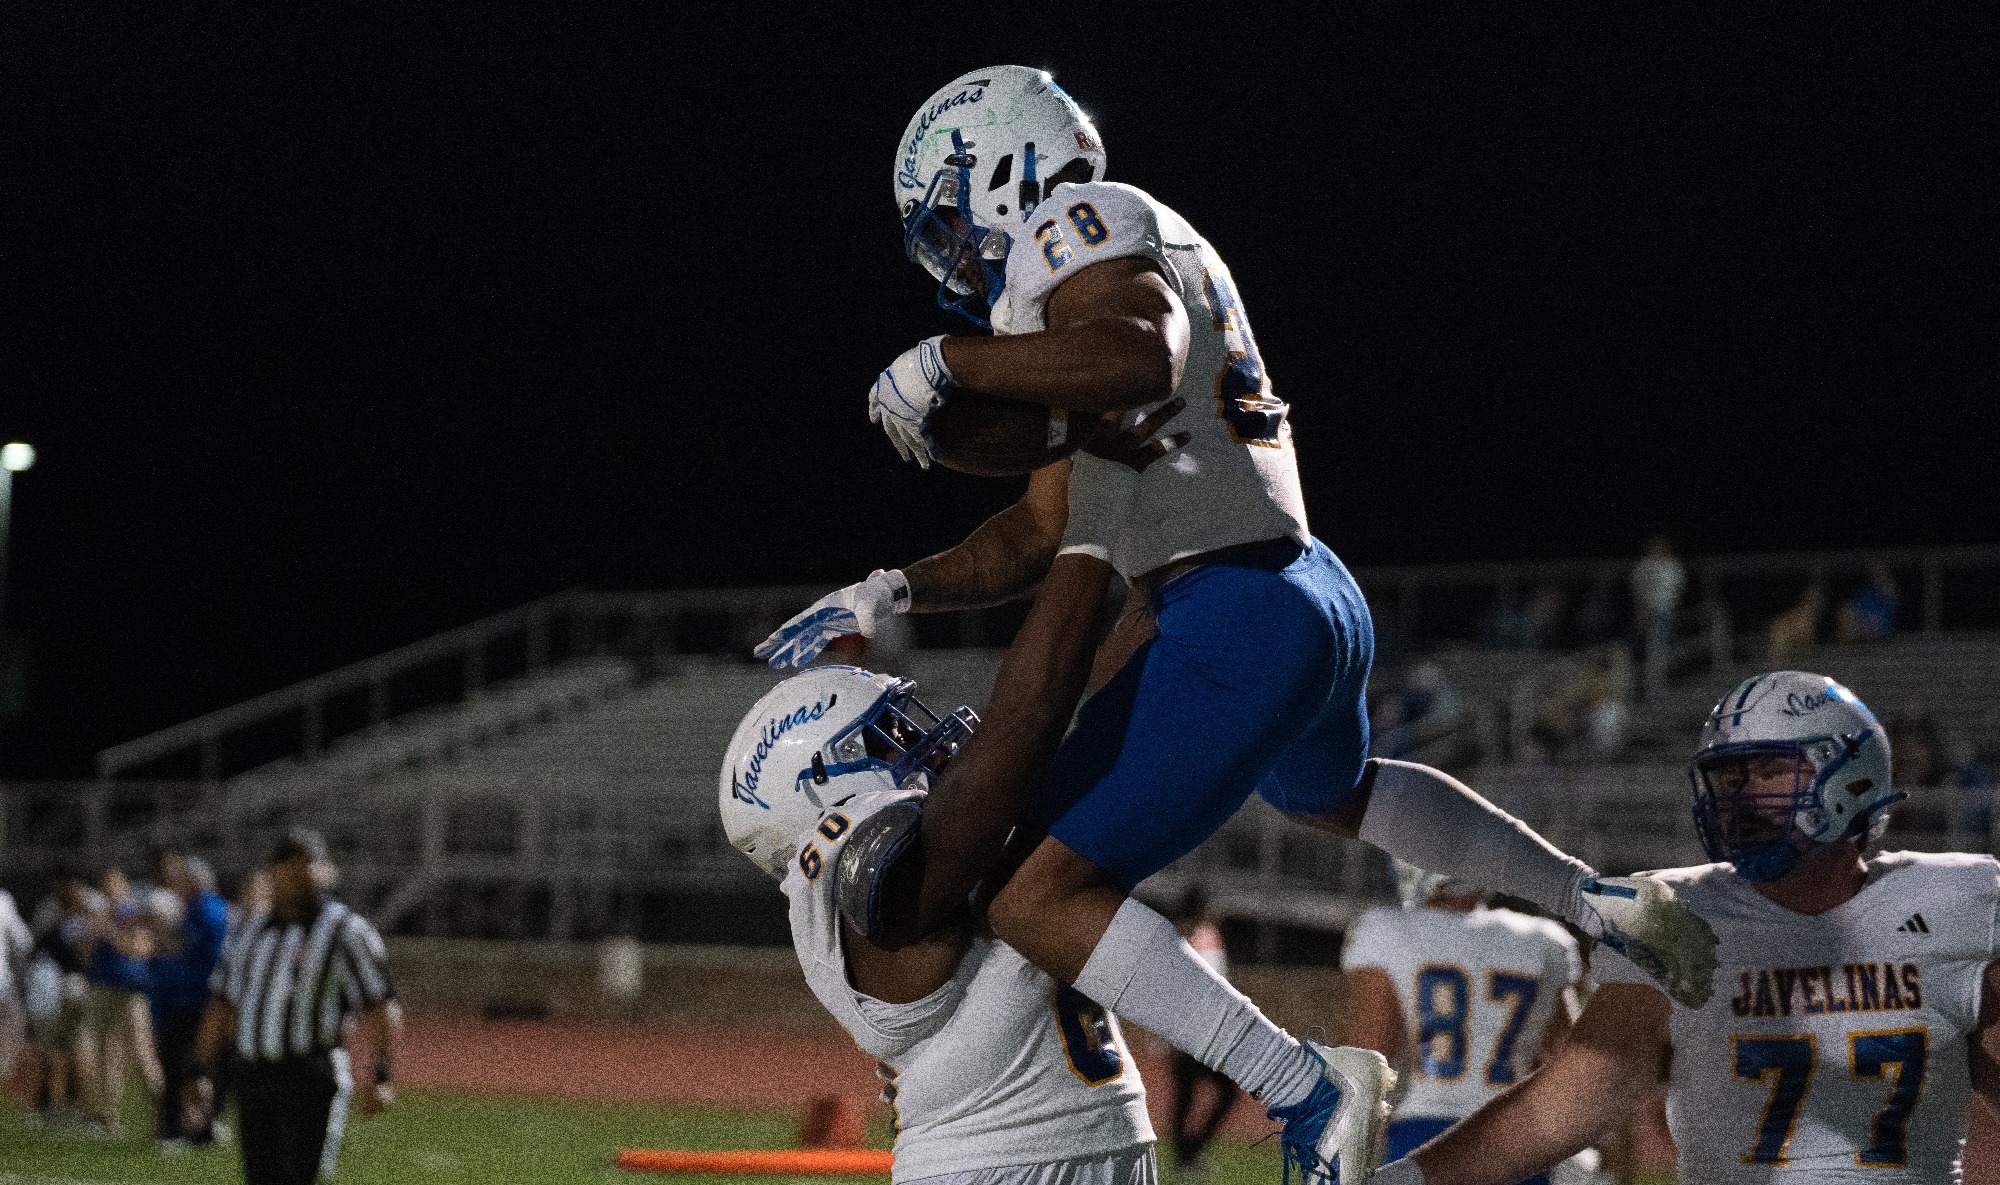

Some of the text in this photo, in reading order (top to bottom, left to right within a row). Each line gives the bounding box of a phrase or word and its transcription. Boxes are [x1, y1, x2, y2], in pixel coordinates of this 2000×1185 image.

[898, 86, 984, 189] Javelinas
[1034, 200, 1110, 274] 28
[734, 697, 828, 810] Javelinas
[797, 811, 852, 883] 60
[1415, 962, 1540, 1087] 87
[1731, 961, 1922, 1019] JAVELINAS
[1730, 1026, 1929, 1169] 77
